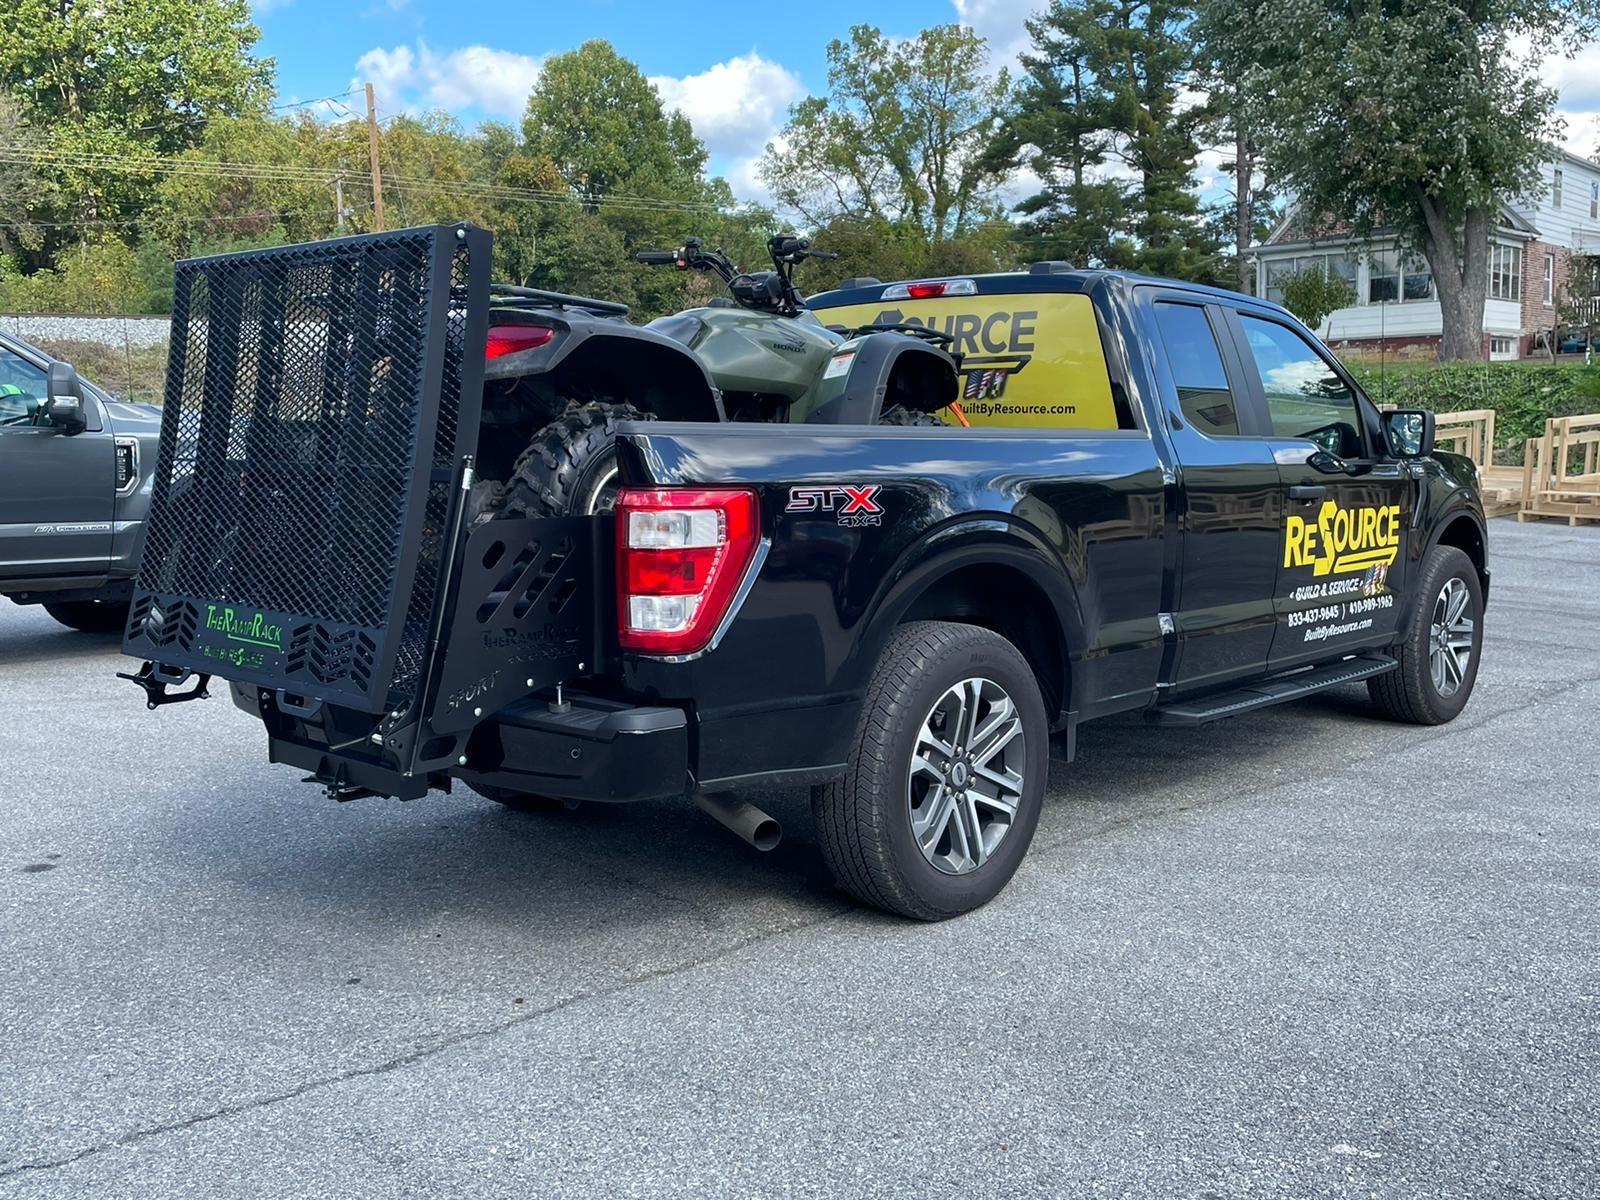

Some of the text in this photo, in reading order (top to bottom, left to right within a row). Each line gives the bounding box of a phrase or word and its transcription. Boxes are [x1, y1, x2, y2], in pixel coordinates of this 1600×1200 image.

[773, 343, 807, 354] HONDA
[785, 485, 886, 518] STX
[1284, 499, 1400, 577] RESOURCE
[1295, 578, 1360, 601] BUILD & SERVICE
[1288, 605, 1339, 627] 833-437-9645
[1304, 618, 1373, 642] BuiltByResource.com
